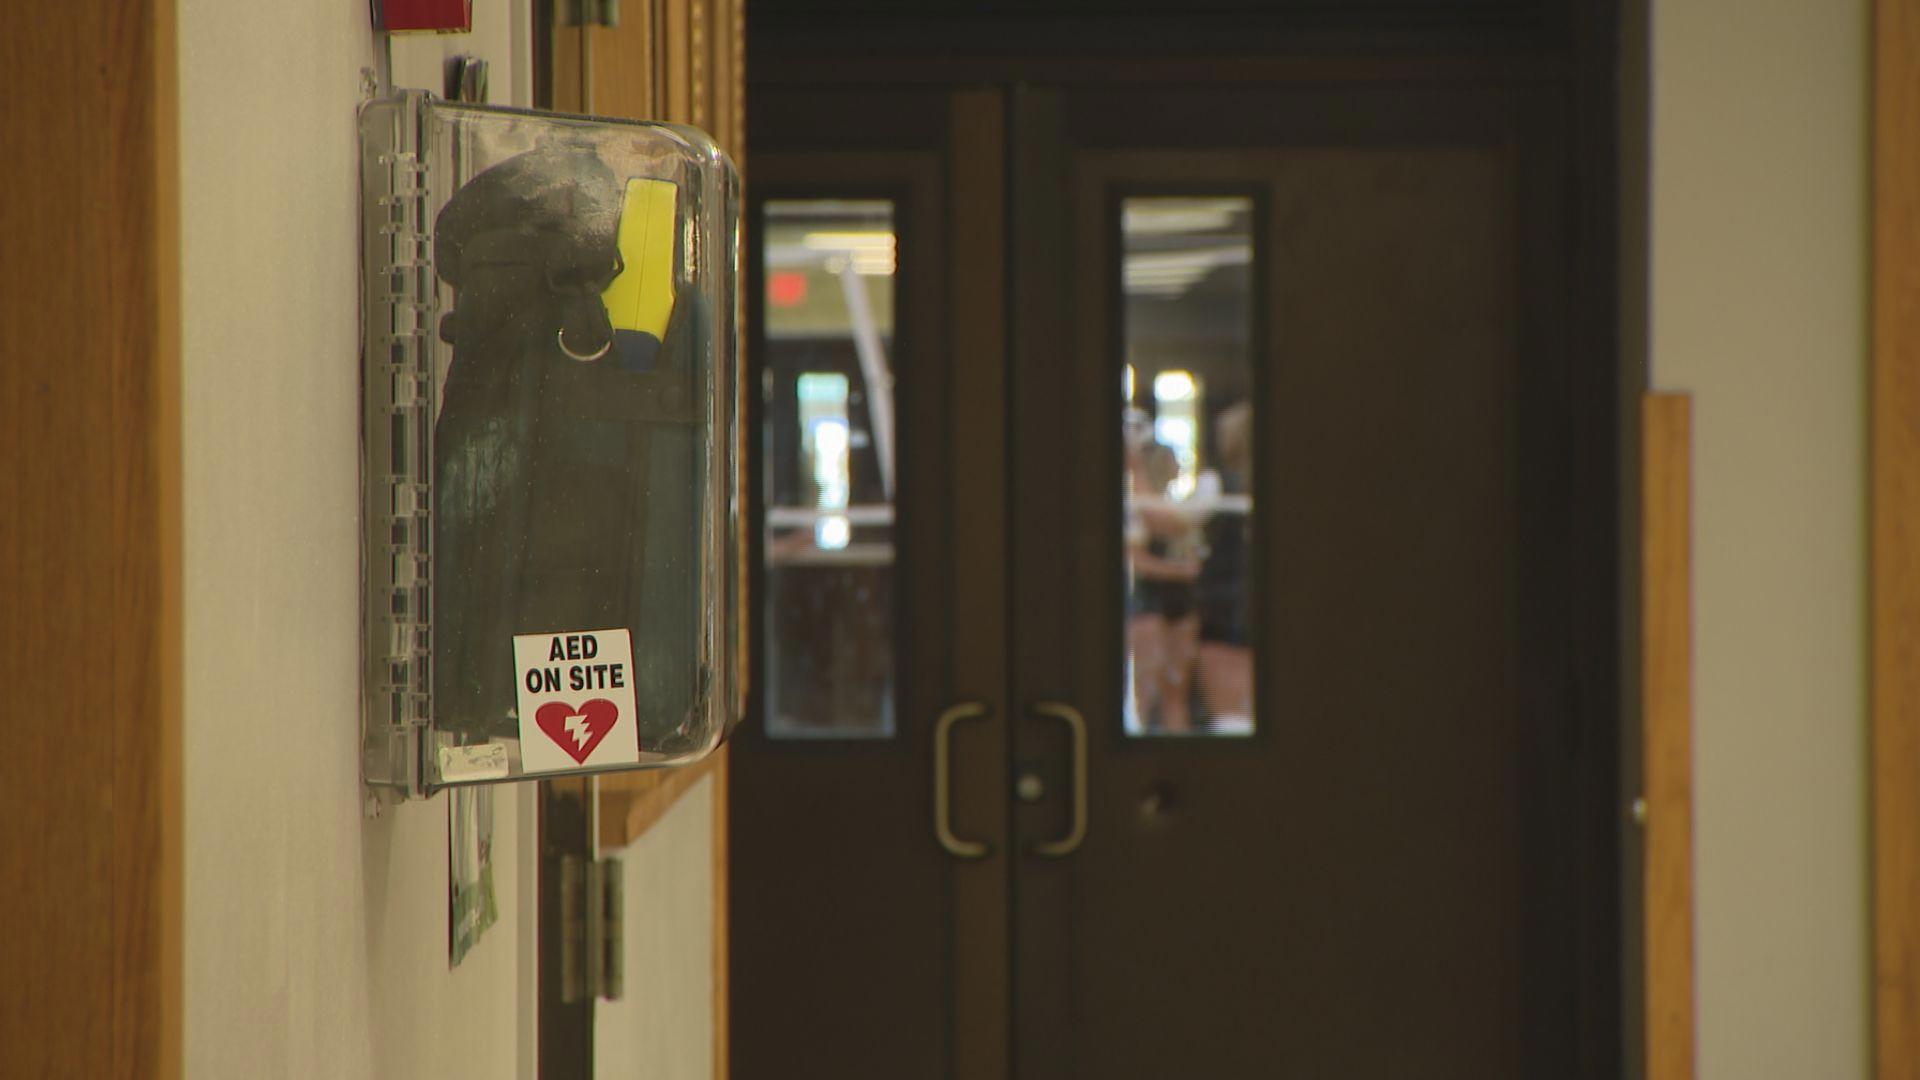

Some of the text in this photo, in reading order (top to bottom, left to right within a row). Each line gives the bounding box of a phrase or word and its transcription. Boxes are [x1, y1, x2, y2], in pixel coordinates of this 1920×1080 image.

[549, 634, 598, 662] AED
[525, 663, 625, 694] ON SITE
